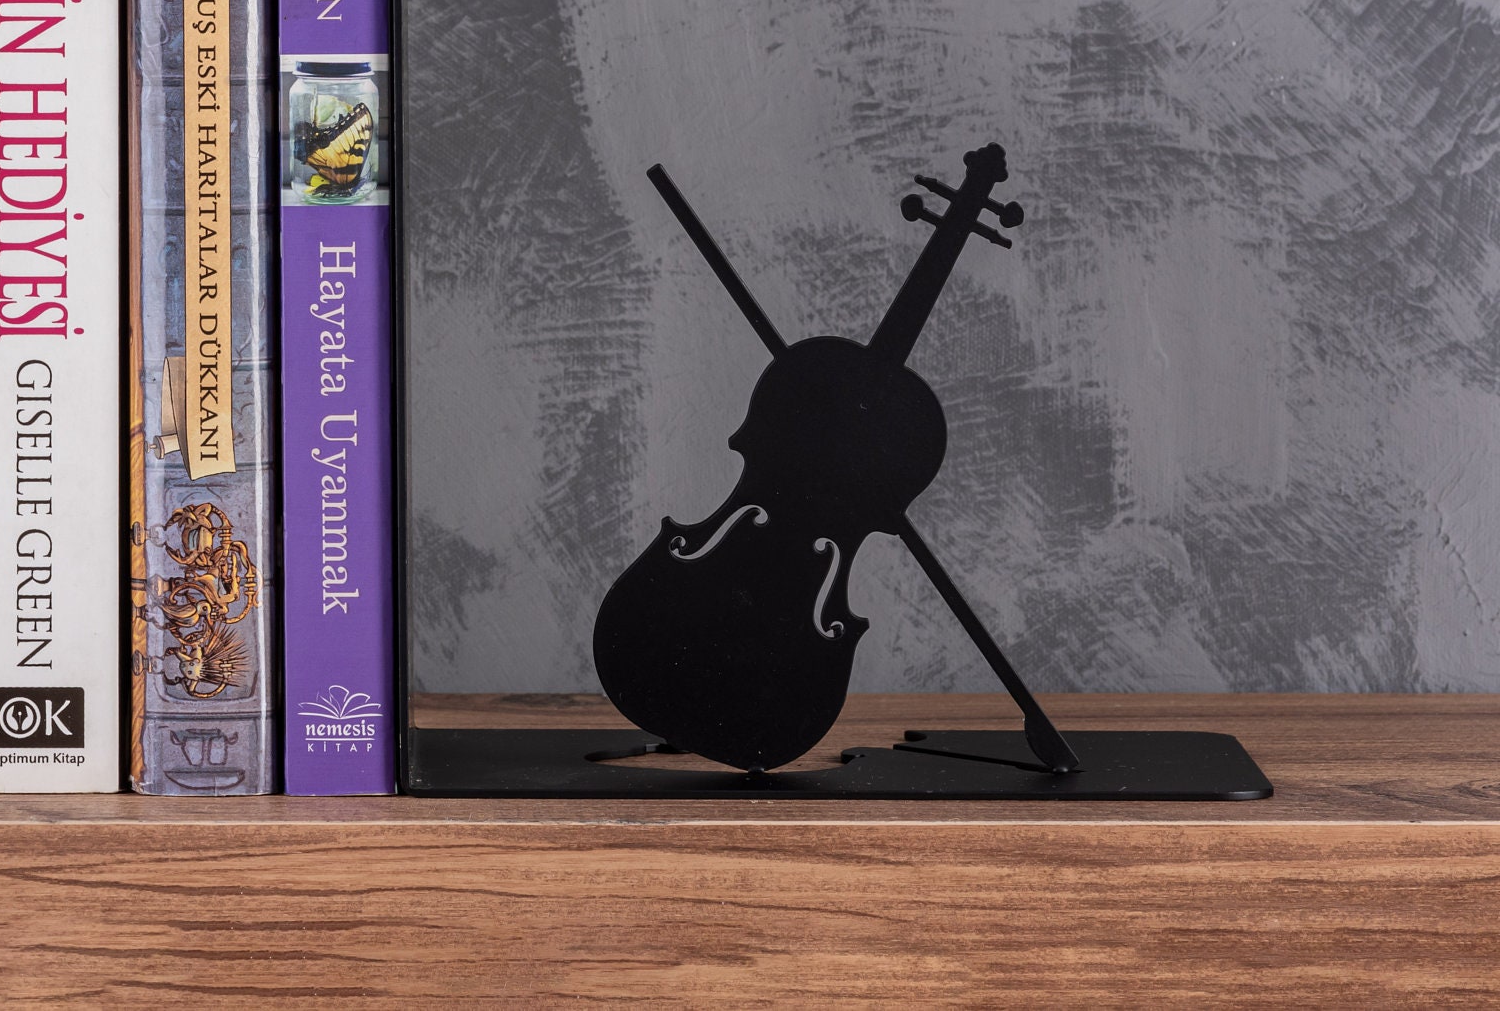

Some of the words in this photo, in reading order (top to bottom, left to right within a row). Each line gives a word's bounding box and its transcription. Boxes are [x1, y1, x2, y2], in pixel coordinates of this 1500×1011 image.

[198, 45, 221, 113] ESKİ
[198, 122, 222, 304] HARİTALAR
[198, 312, 222, 462] DÜKKANI
[310, 240, 356, 397] Hayata
[14, 359, 54, 516] GISELLE
[310, 409, 360, 615] Uyanmak
[14, 529, 54, 671] GREEN
[54, 752, 85, 766] Kitap
[304, 720, 376, 737] nemesis
[307, 741, 374, 753] KİTAP
